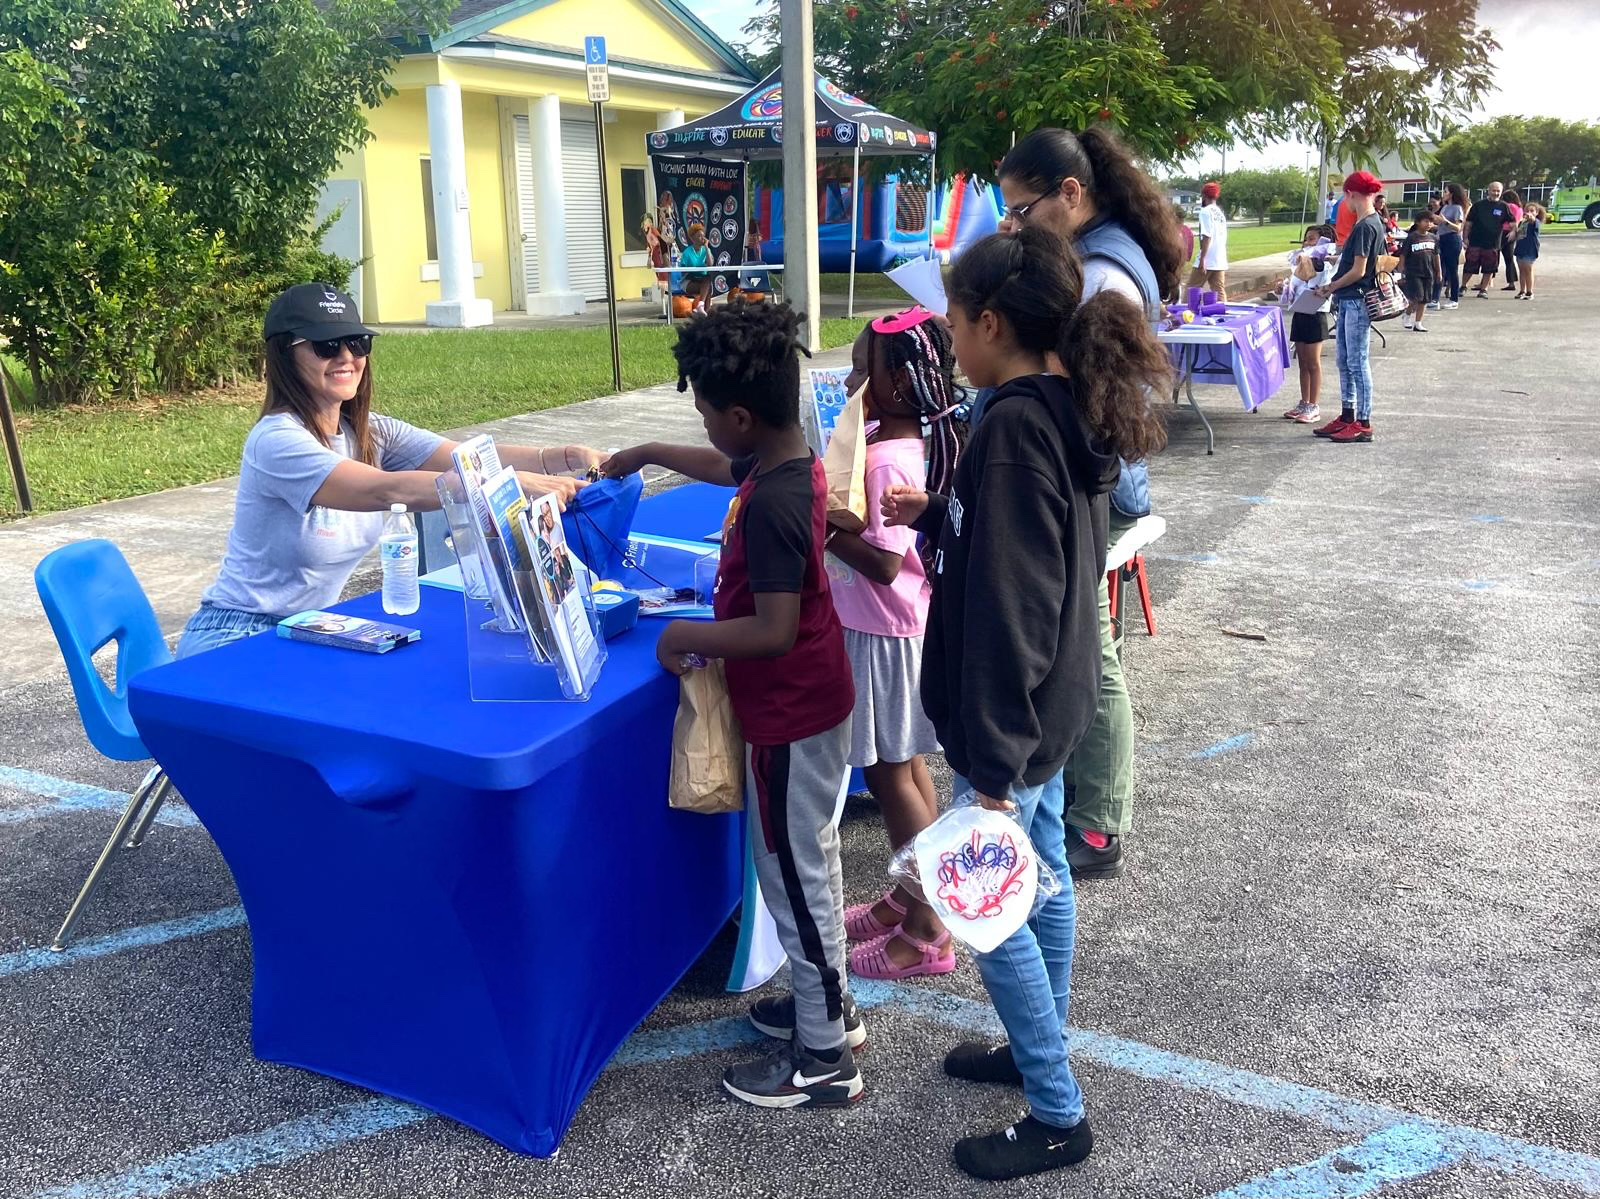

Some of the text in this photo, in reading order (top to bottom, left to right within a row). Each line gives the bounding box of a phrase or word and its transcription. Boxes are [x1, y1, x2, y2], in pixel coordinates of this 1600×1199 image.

[674, 128, 766, 144] INSPIRE EDUCATE
[708, 166, 725, 177] WITH
